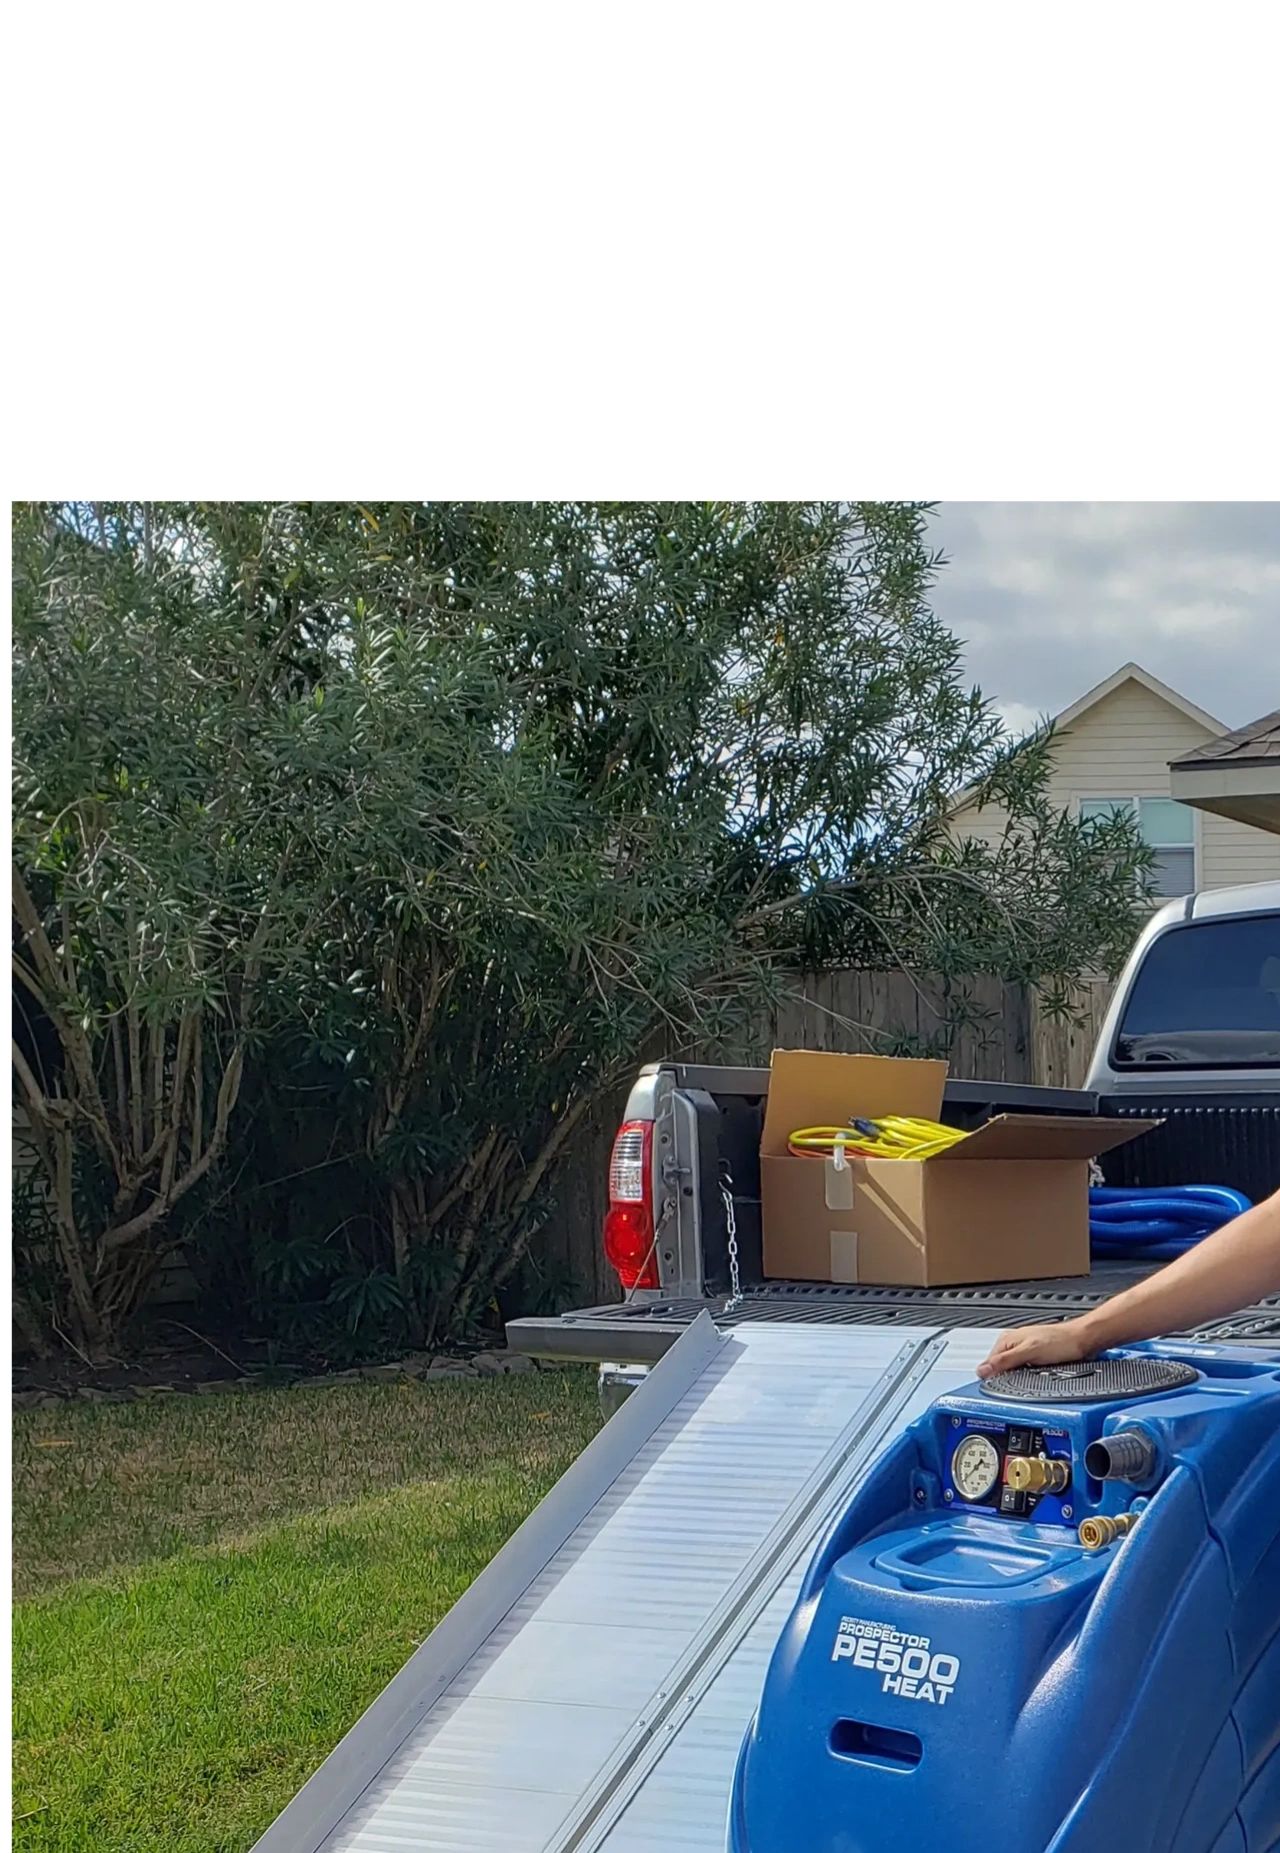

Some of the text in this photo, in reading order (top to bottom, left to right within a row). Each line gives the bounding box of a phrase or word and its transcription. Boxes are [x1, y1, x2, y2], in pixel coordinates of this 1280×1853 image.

[838, 1621, 931, 1650] PROSPECTOR
[831, 1633, 961, 1686] PE500
[882, 1673, 954, 1705] HEAT
